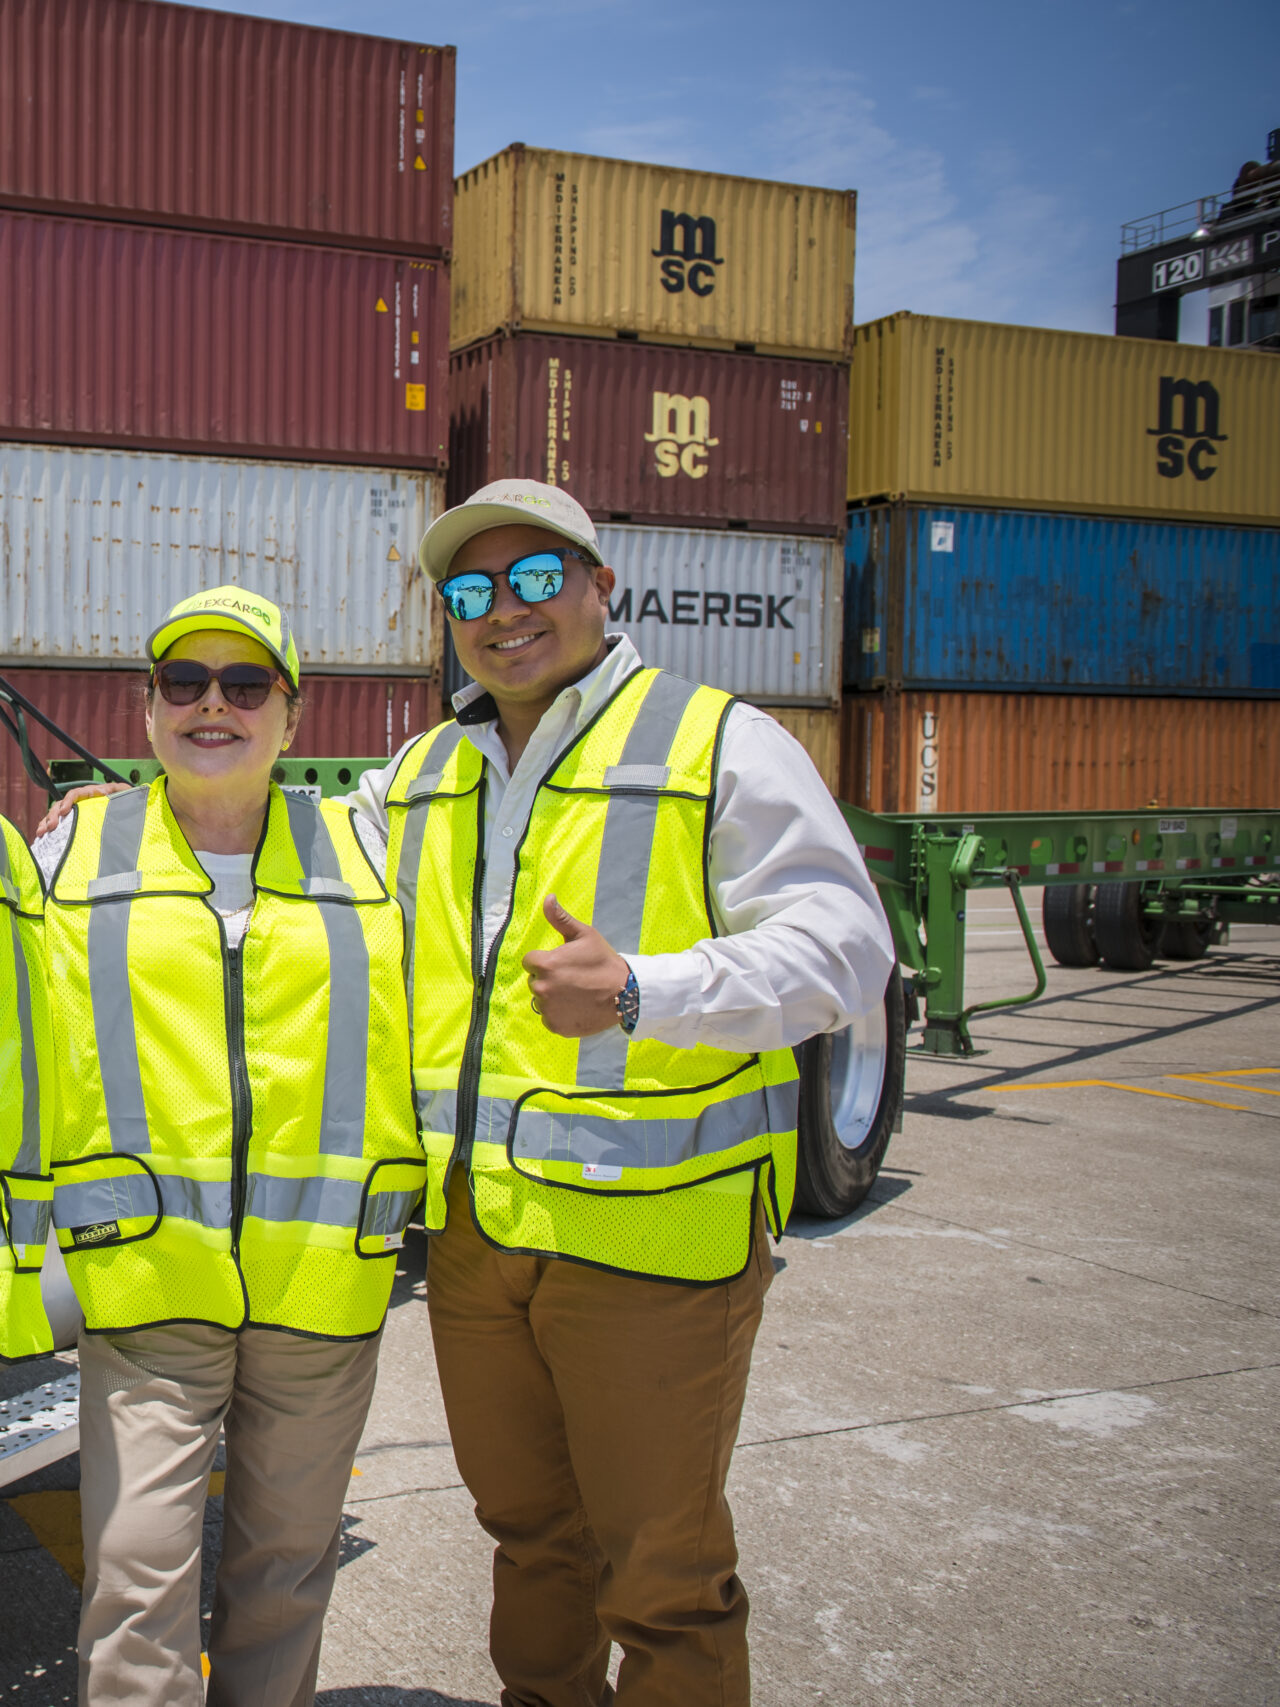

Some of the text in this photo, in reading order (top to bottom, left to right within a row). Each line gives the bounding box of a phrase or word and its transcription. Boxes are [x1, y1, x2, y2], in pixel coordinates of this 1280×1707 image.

[553, 172, 565, 305] MEDITERRANEAN
[569, 184, 578, 296] SHIPPING CO
[1155, 254, 1200, 287] 120
[933, 347, 945, 467] MEDITERRANEAN
[561, 460, 570, 482] CO
[204, 598, 271, 627] EXCARGO
[607, 588, 796, 629] MAERSK
[921, 714, 938, 796] UCS
